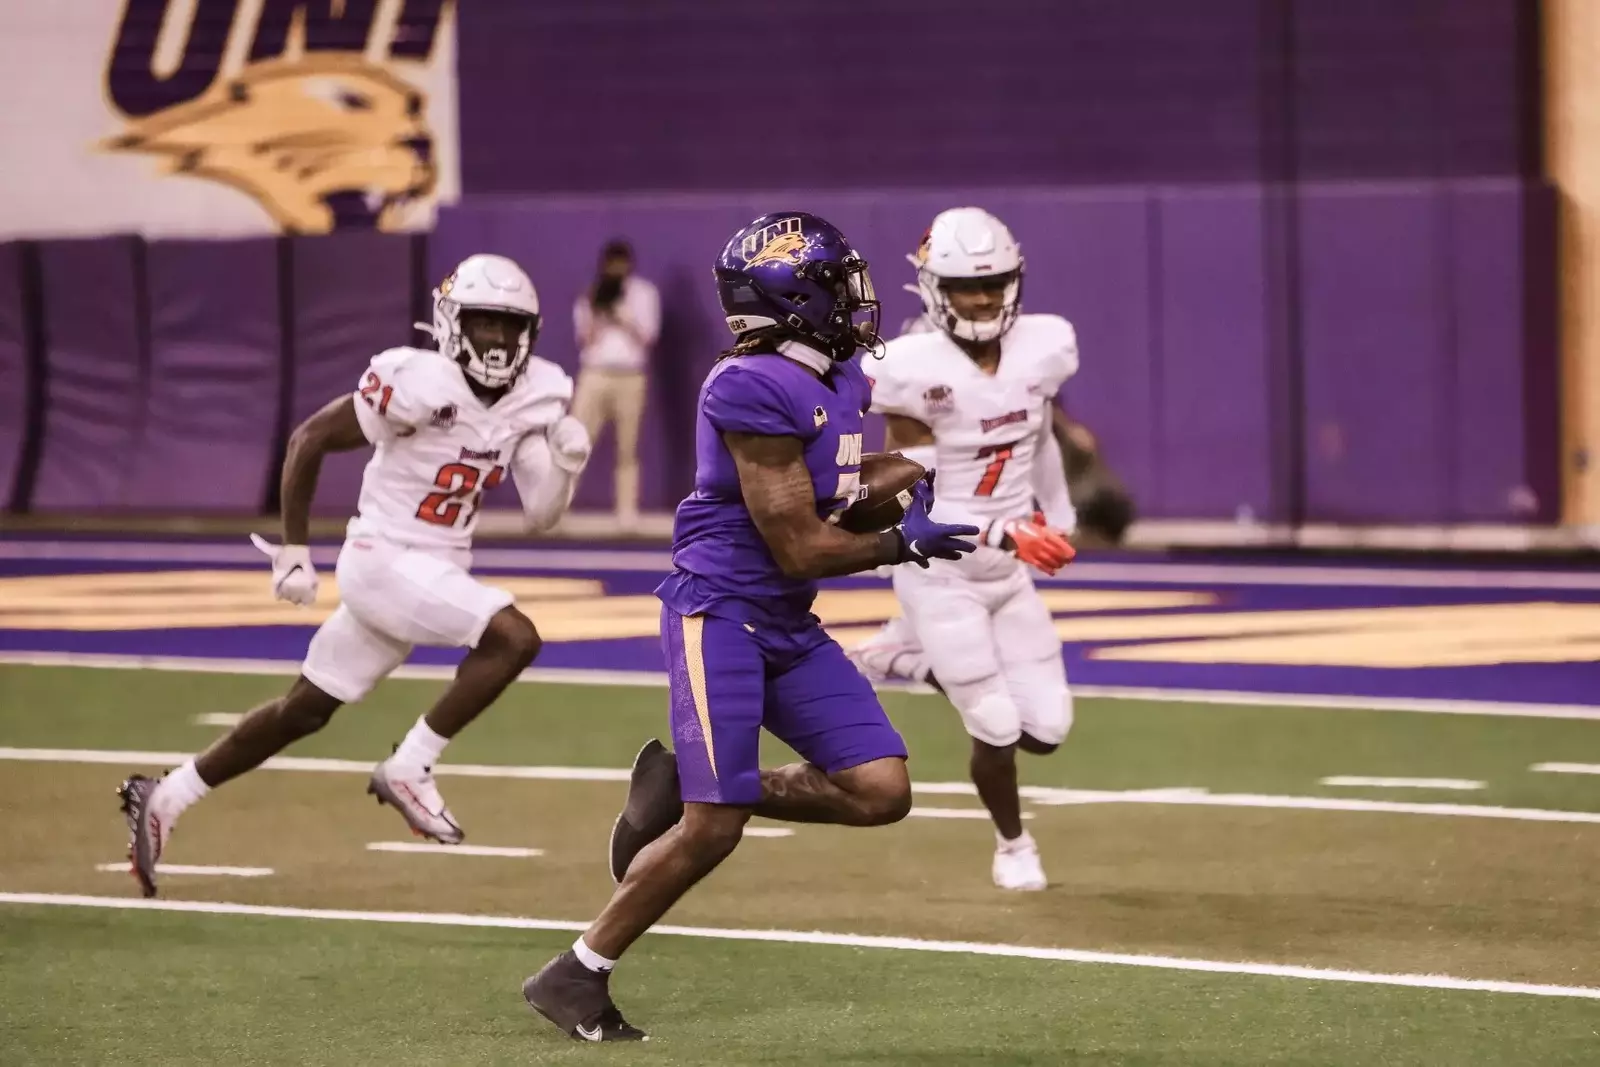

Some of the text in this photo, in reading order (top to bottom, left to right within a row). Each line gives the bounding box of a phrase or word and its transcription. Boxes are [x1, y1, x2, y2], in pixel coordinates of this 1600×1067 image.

[742, 216, 802, 263] UNI
[361, 371, 393, 416] 21
[973, 440, 1020, 497] 7
